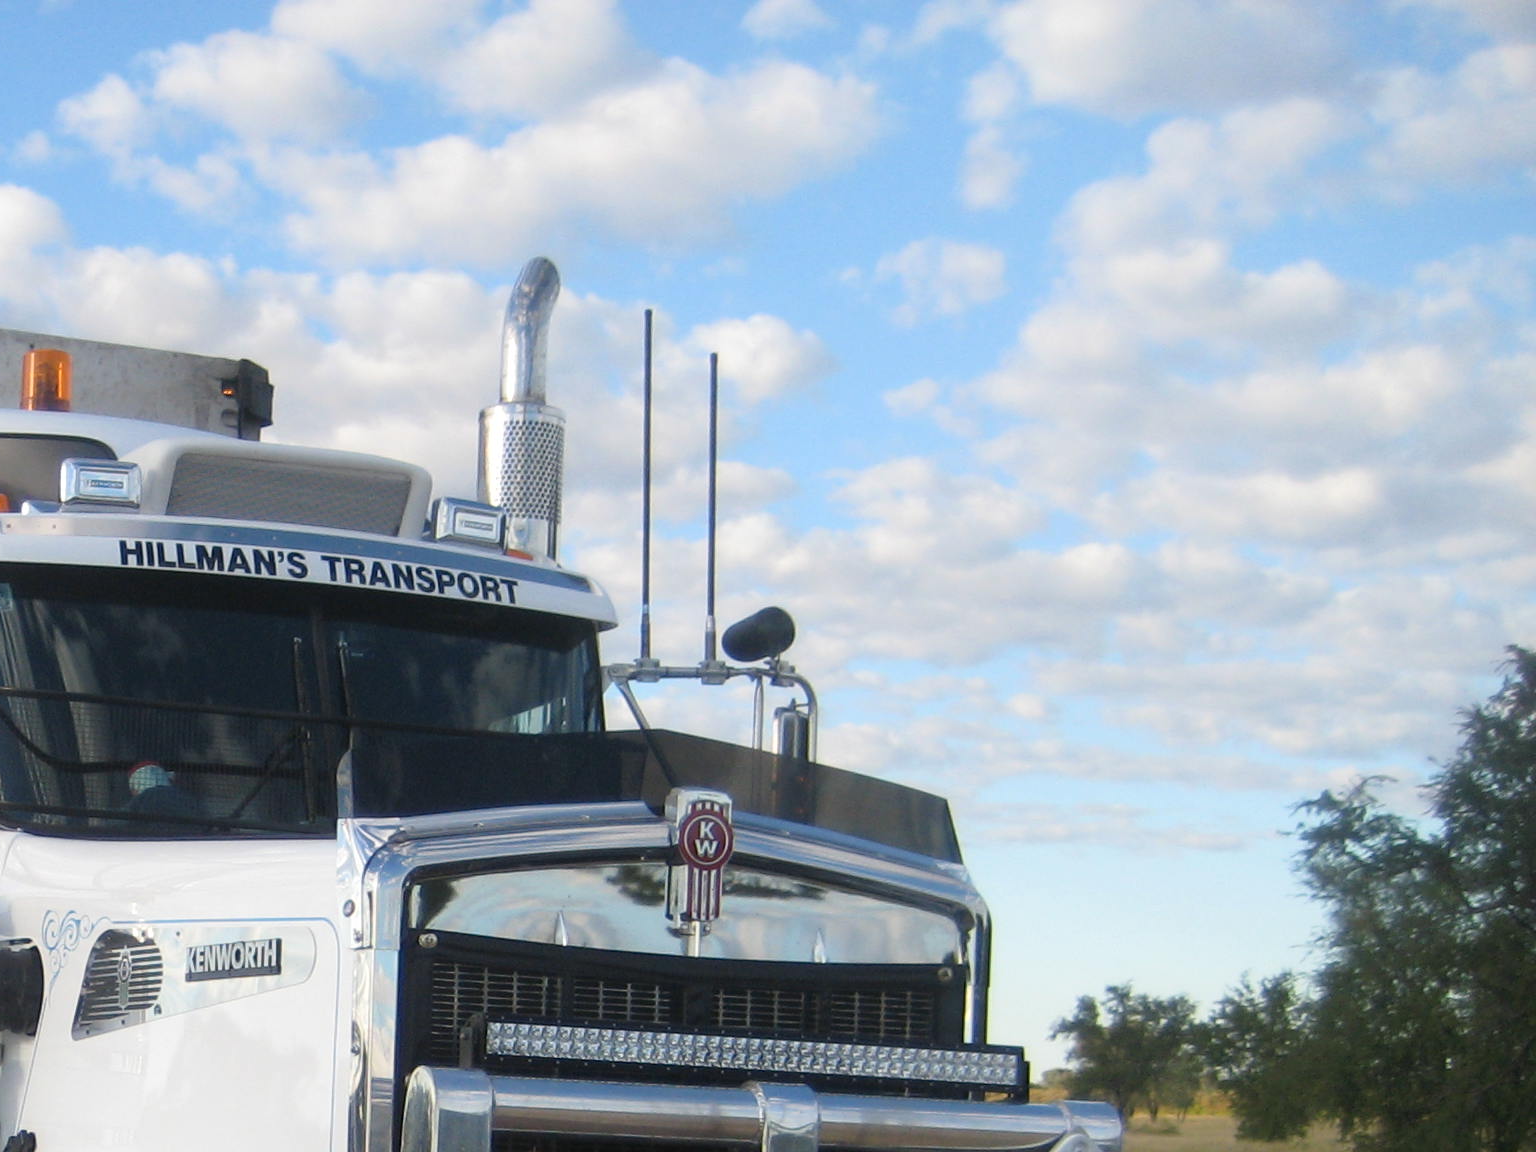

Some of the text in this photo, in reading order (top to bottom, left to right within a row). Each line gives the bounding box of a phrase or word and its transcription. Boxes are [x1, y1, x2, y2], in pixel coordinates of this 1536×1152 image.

[119, 539, 518, 605] HILLMAN'S TRANSPORT
[185, 938, 277, 974] KENWORTH
